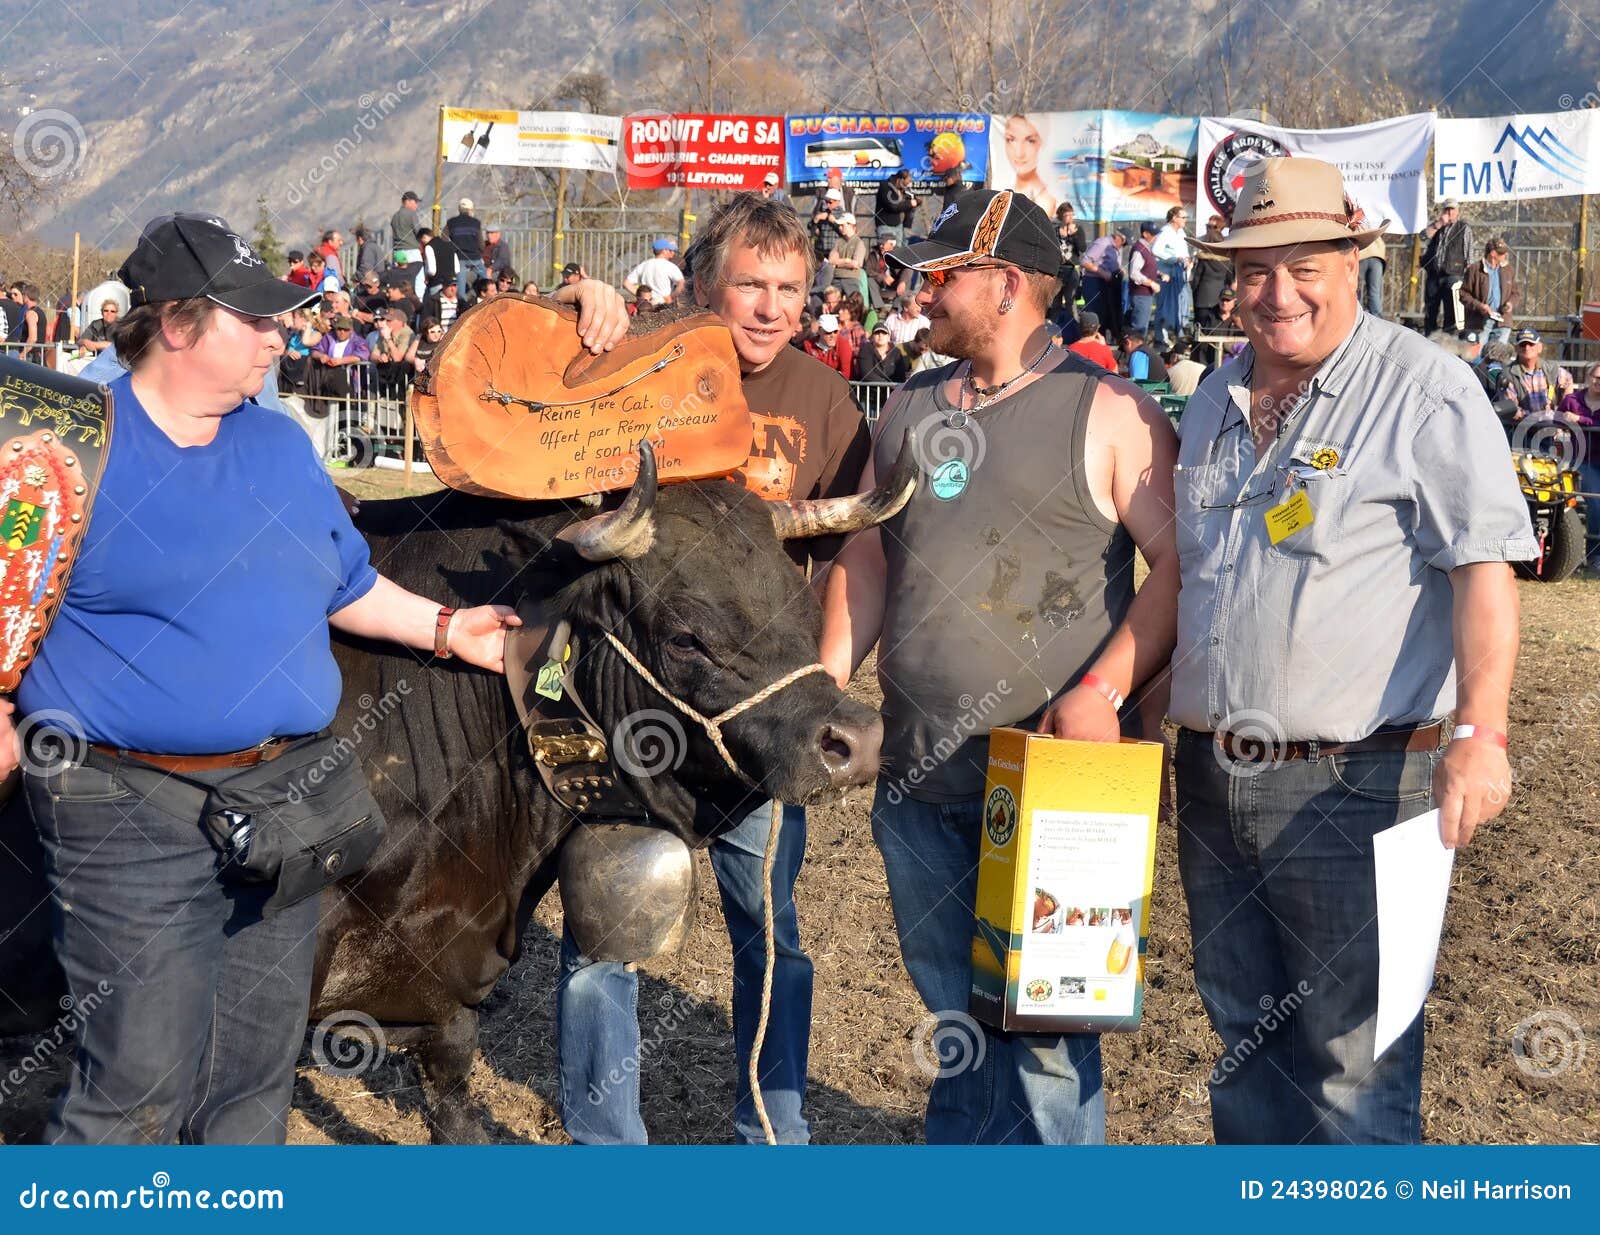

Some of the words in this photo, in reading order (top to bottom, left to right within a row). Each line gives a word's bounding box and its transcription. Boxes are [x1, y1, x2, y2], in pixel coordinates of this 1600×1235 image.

[631, 119, 704, 144] RODUIT
[706, 119, 749, 144] JPG
[753, 121, 780, 144] SA
[789, 117, 910, 136] BUCHARD
[914, 117, 986, 134] voyages
[708, 153, 780, 166] CHARPENTE
[687, 172, 744, 185] LEYTRON
[1211, 151, 1227, 204] COLLEGE
[1439, 160, 1517, 195] FMV
[1517, 182, 1563, 193] www.fmv.ch
[539, 405, 581, 423] Reine
[622, 394, 654, 412] Cat.
[540, 430, 580, 450] Offert
[588, 427, 611, 446] par
[618, 419, 652, 440] Rémy
[574, 446, 586, 462] et
[595, 446, 621, 460] son
[988, 789, 1014, 812] BOXER
